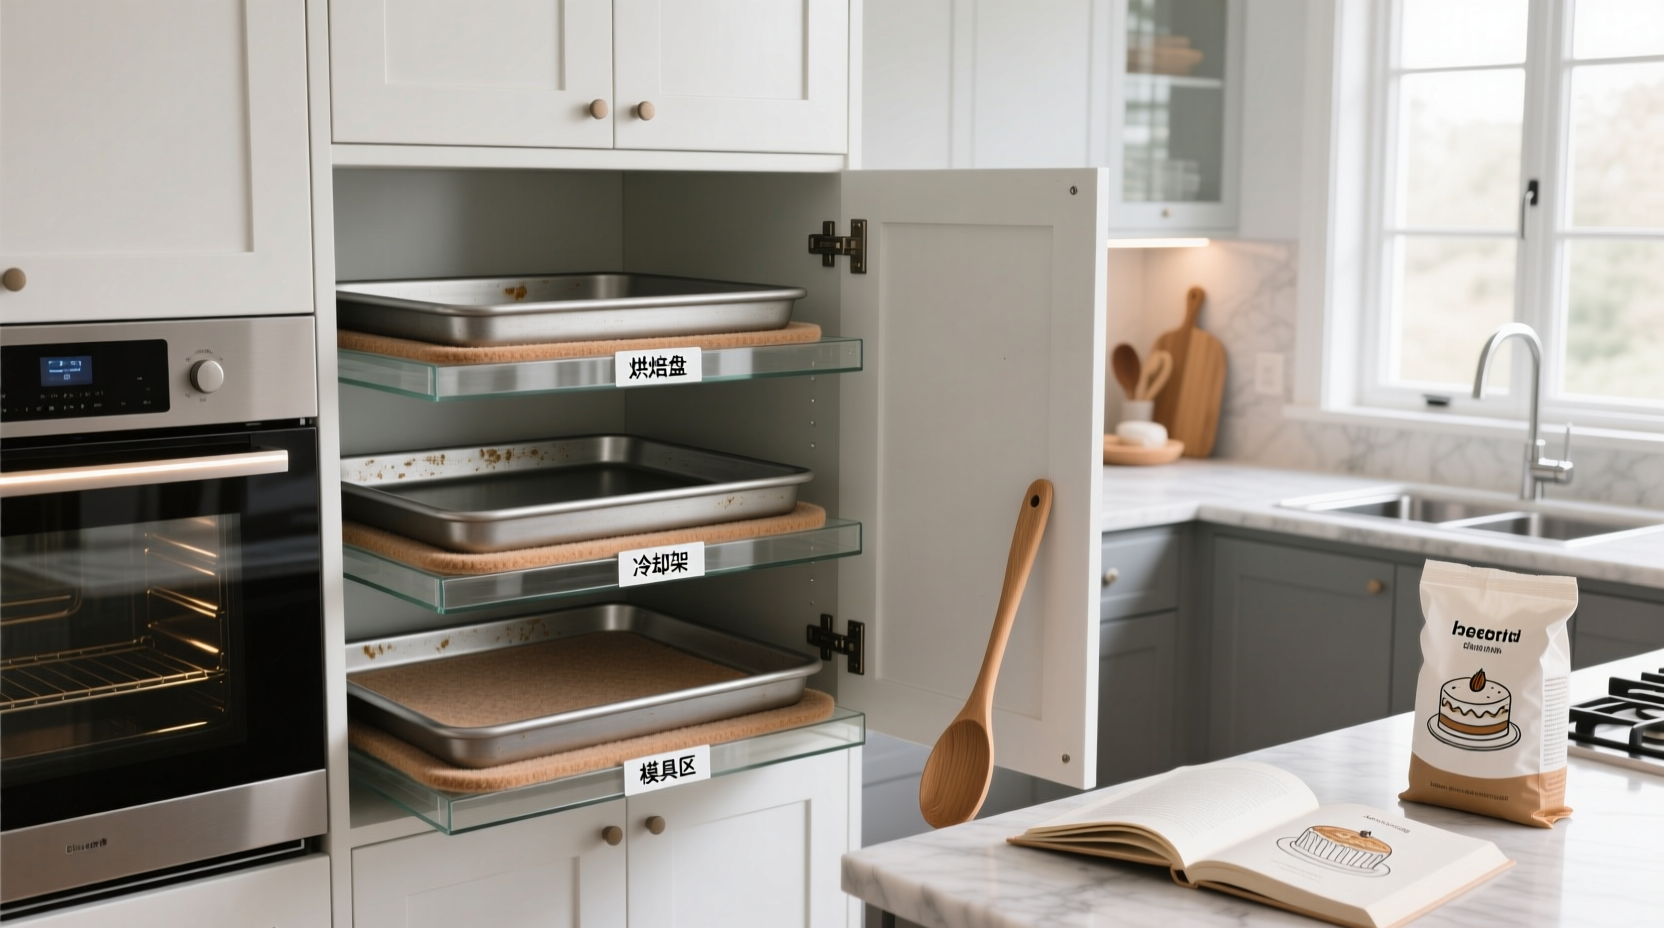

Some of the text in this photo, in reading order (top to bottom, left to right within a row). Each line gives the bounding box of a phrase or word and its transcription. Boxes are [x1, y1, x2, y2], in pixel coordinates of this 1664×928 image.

[629, 354, 687, 379] 烘焙盘
[633, 550, 688, 577] 冷却架
[639, 754, 696, 785] 模具区
